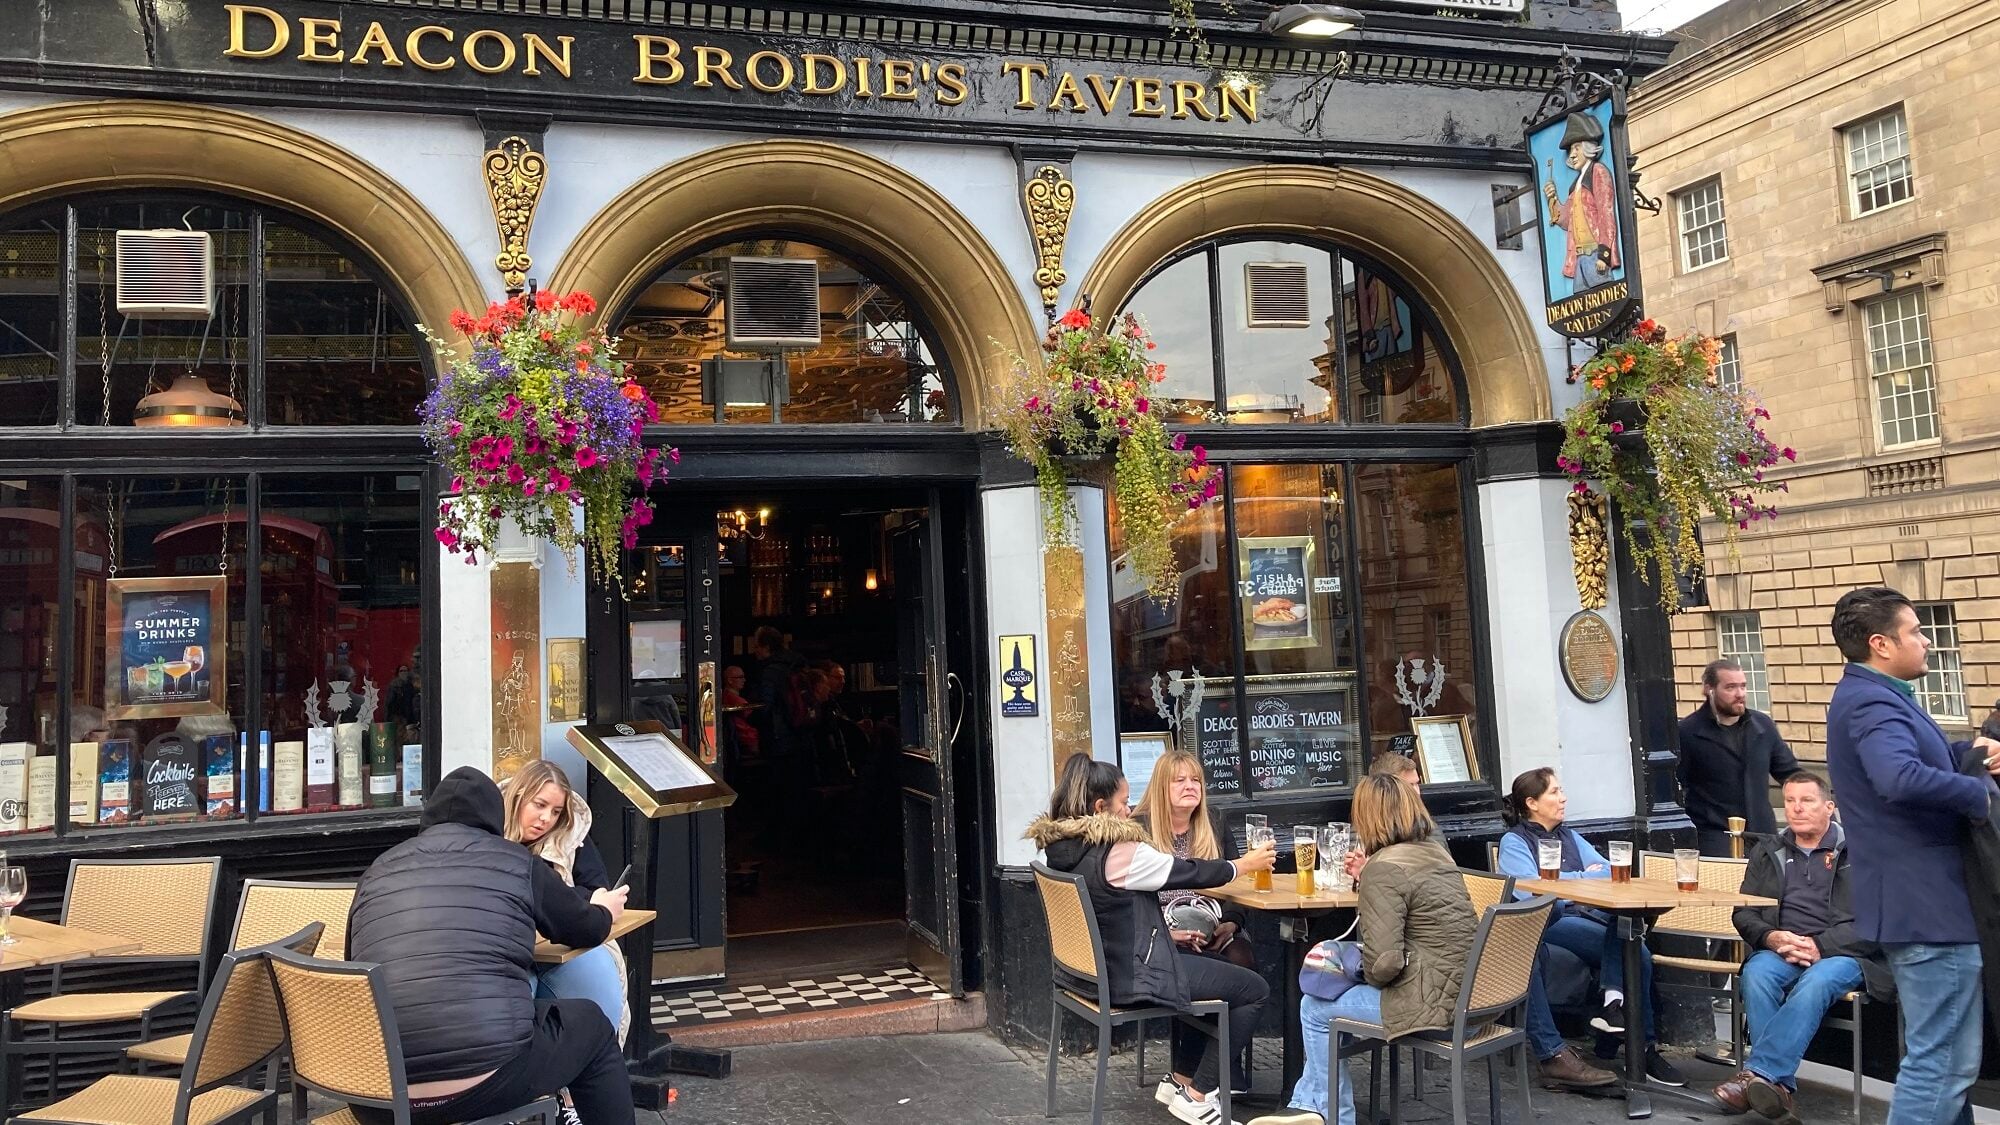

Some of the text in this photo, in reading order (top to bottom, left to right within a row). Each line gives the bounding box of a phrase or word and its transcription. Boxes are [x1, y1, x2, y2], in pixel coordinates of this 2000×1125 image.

[223, 3, 1260, 124] DEACON BRODIE'S TAVERN
[1547, 282, 1628, 325] DEACON BRODIE'S
[1564, 308, 1612, 333] TAVERN
[1256, 573, 1285, 584] FISH
[135, 618, 200, 629] SUMMER
[139, 629, 196, 640] DRINKS
[1251, 713, 1295, 729] BRODIES
[1300, 711, 1342, 727] TAVERN
[1311, 738, 1337, 749] LIVE
[1394, 736, 1413, 745] TAKE
[1214, 756, 1240, 766] MALTS
[1250, 748, 1296, 762] DINING
[1305, 750, 1342, 763] MUSIC
[147, 759, 195, 785] Cocktails
[1251, 764, 1296, 777] UPSTAIRS
[1218, 779, 1240, 790] GINS
